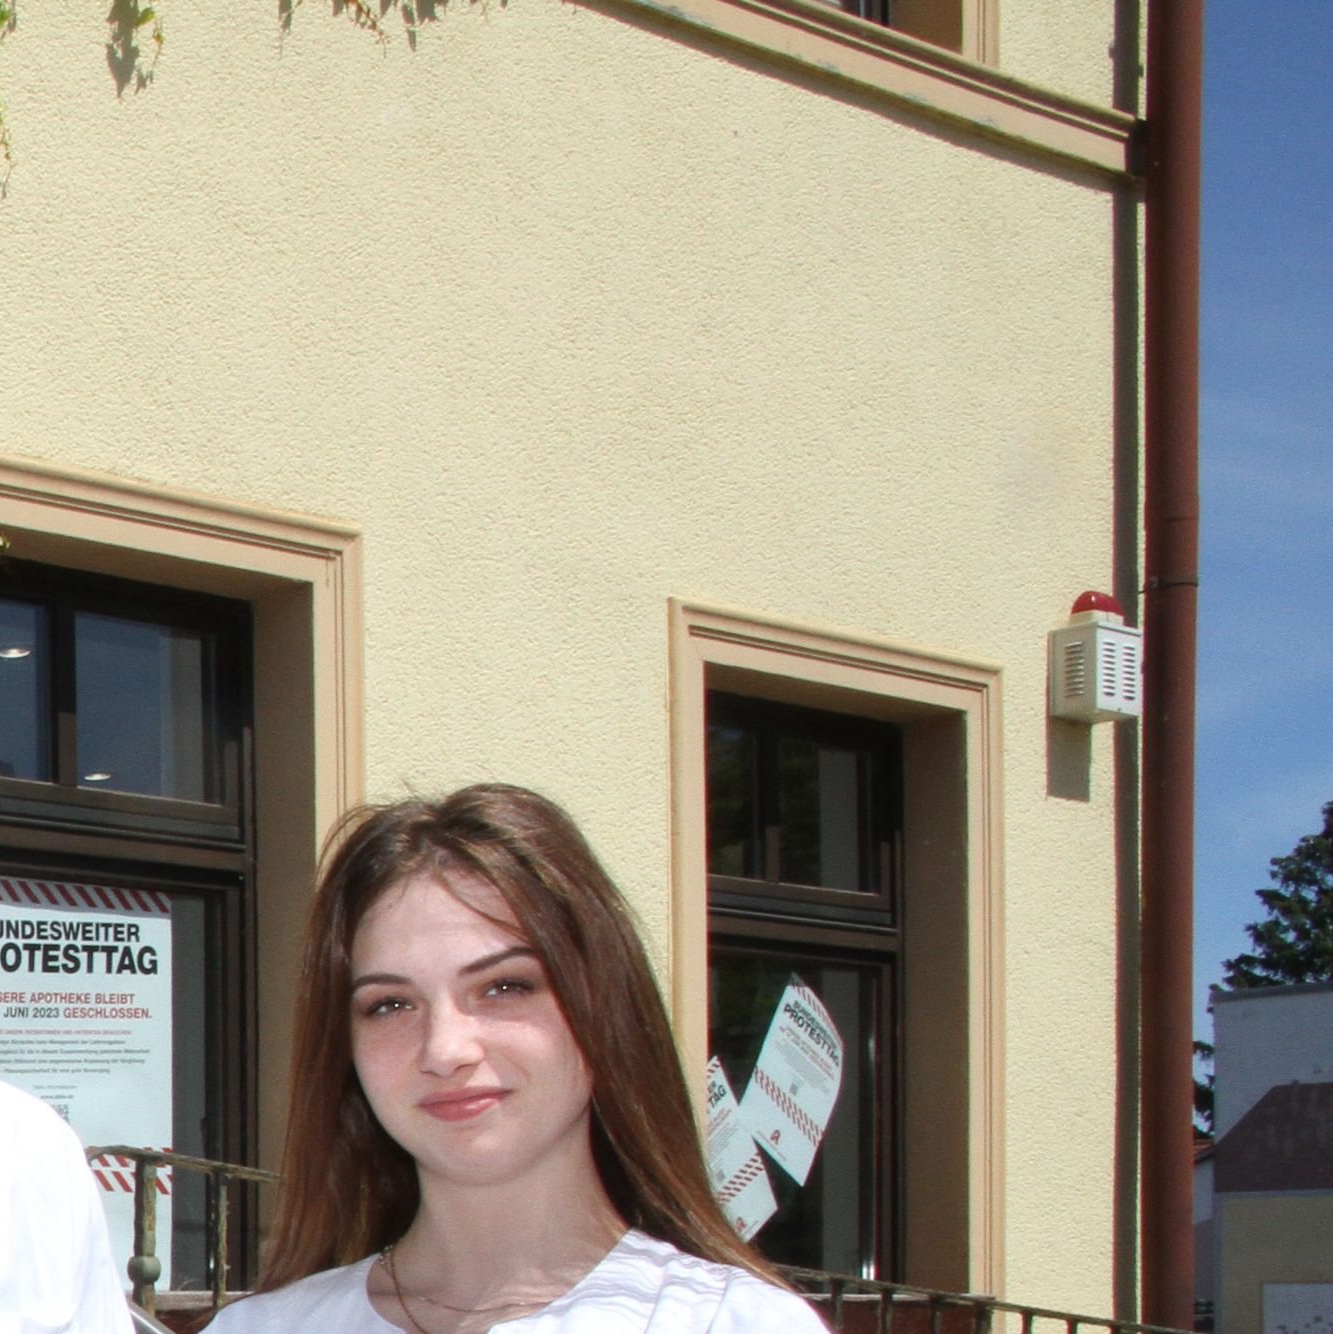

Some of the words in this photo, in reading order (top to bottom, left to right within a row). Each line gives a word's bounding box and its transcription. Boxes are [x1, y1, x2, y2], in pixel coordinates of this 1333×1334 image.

[30, 992, 90, 1004] APOTHEKE
[94, 993, 135, 1005] BLEIBT
[4, 1007, 29, 1018] JUNI
[33, 1007, 59, 1019] 2023
[63, 1007, 152, 1020] GESCHLOSSEN.
